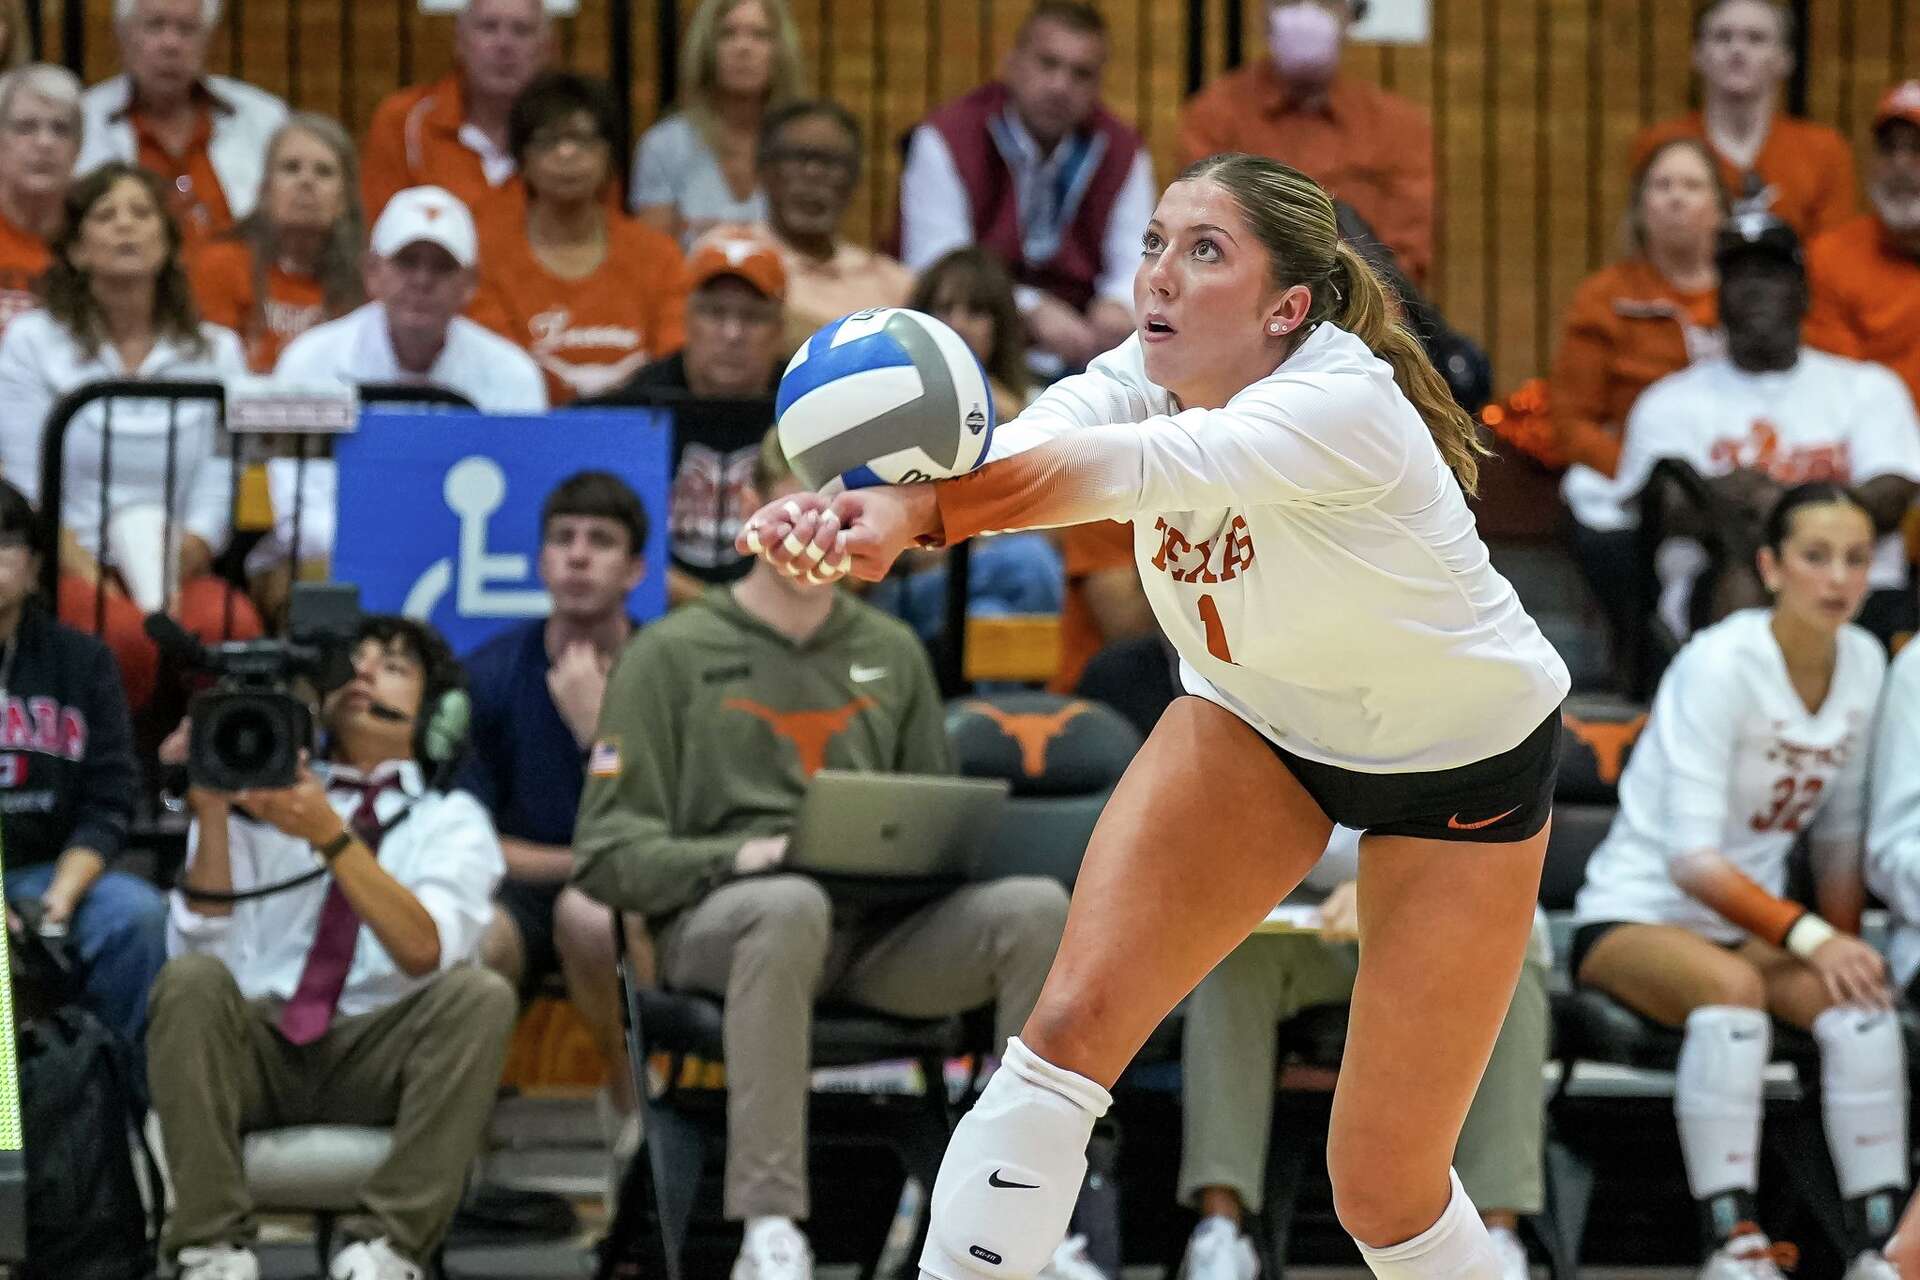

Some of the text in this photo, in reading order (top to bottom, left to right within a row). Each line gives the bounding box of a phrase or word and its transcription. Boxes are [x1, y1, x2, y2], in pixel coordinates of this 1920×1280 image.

[1151, 514, 1256, 584] TEXAS
[1198, 594, 1233, 664] 1
[1749, 777, 1825, 833] 32
